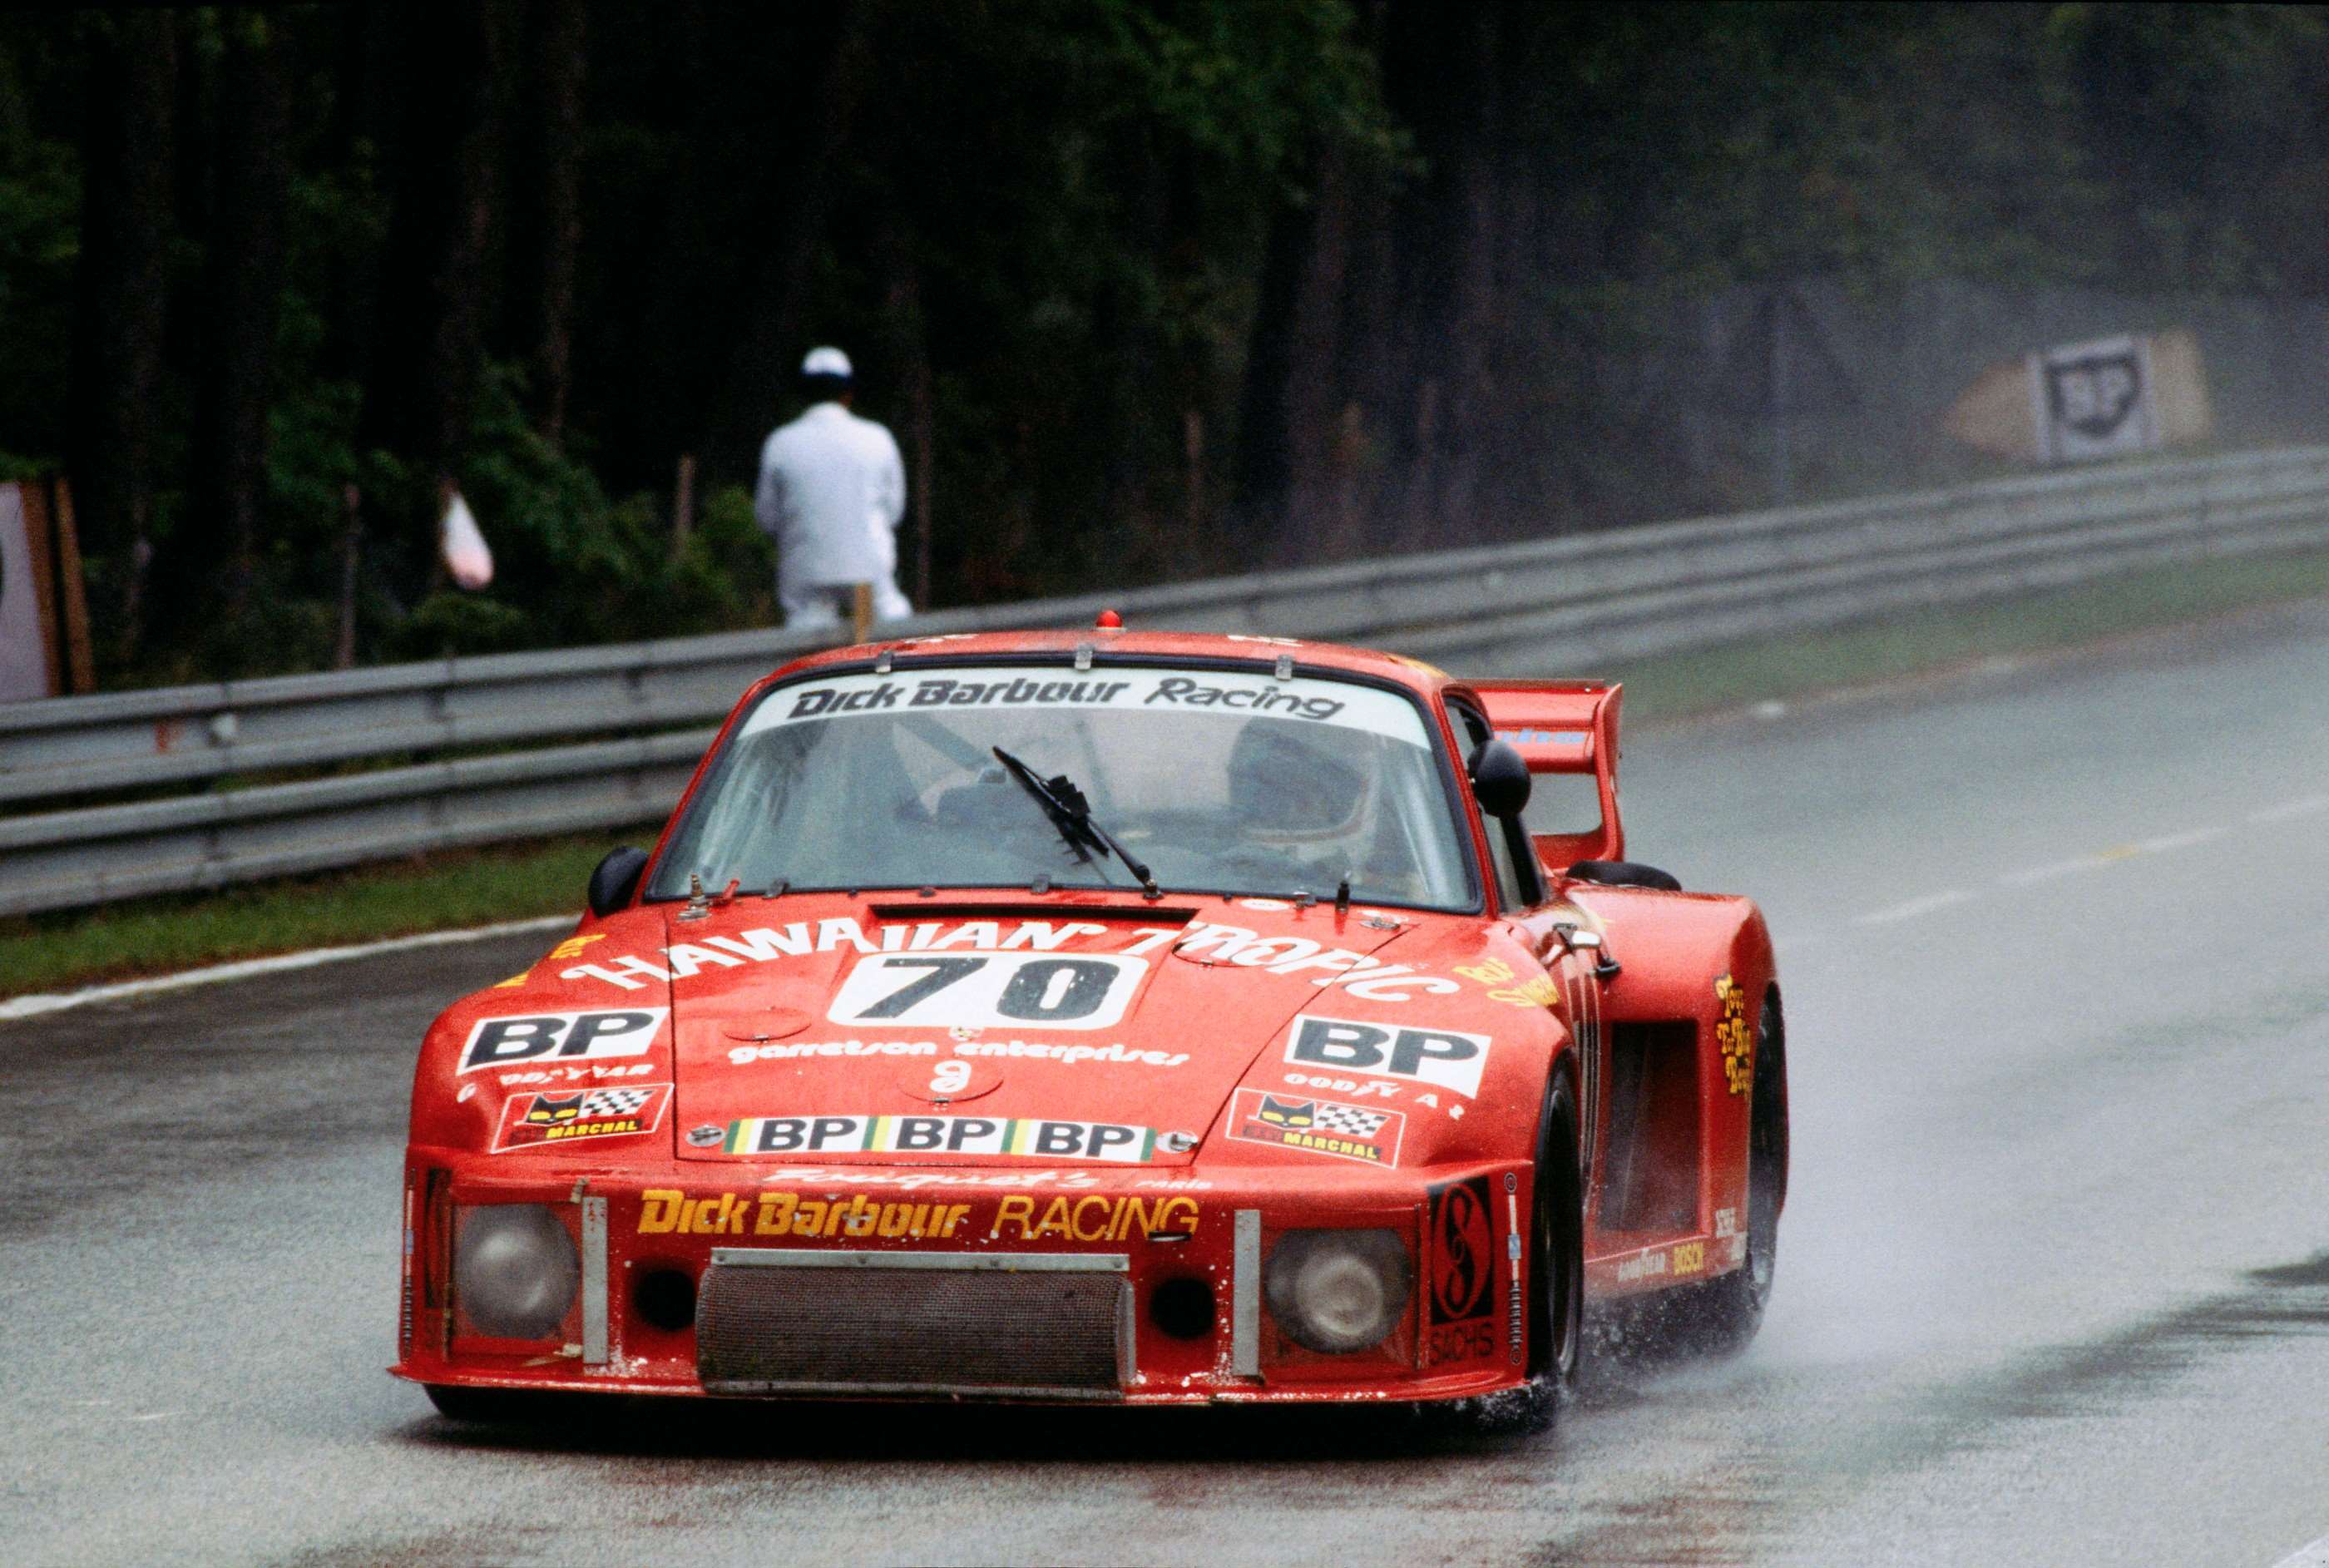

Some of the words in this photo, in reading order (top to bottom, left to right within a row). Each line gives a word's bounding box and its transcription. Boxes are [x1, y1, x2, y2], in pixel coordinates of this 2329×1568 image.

[787, 681, 904, 720] Dick
[907, 677, 1131, 708] Barbour
[1144, 678, 1346, 720] Racing
[559, 916, 1109, 991] HAWAIIAN
[1117, 919, 1461, 1002] TROPIC
[853, 957, 1120, 1021] 70
[463, 1011, 655, 1068] BP
[727, 1039, 937, 1065] garretson
[952, 1040, 1190, 1066] enterprises
[1292, 1018, 1480, 1075] BP
[546, 1120, 639, 1139] MARCHAL
[755, 1118, 859, 1152] BP
[894, 1116, 996, 1151] BP
[1033, 1121, 1137, 1159] BP
[1283, 1131, 1379, 1160] MARCHAL
[636, 1189, 754, 1235] Dick
[752, 1191, 973, 1239] Barbour
[991, 1195, 1200, 1242] RACING
